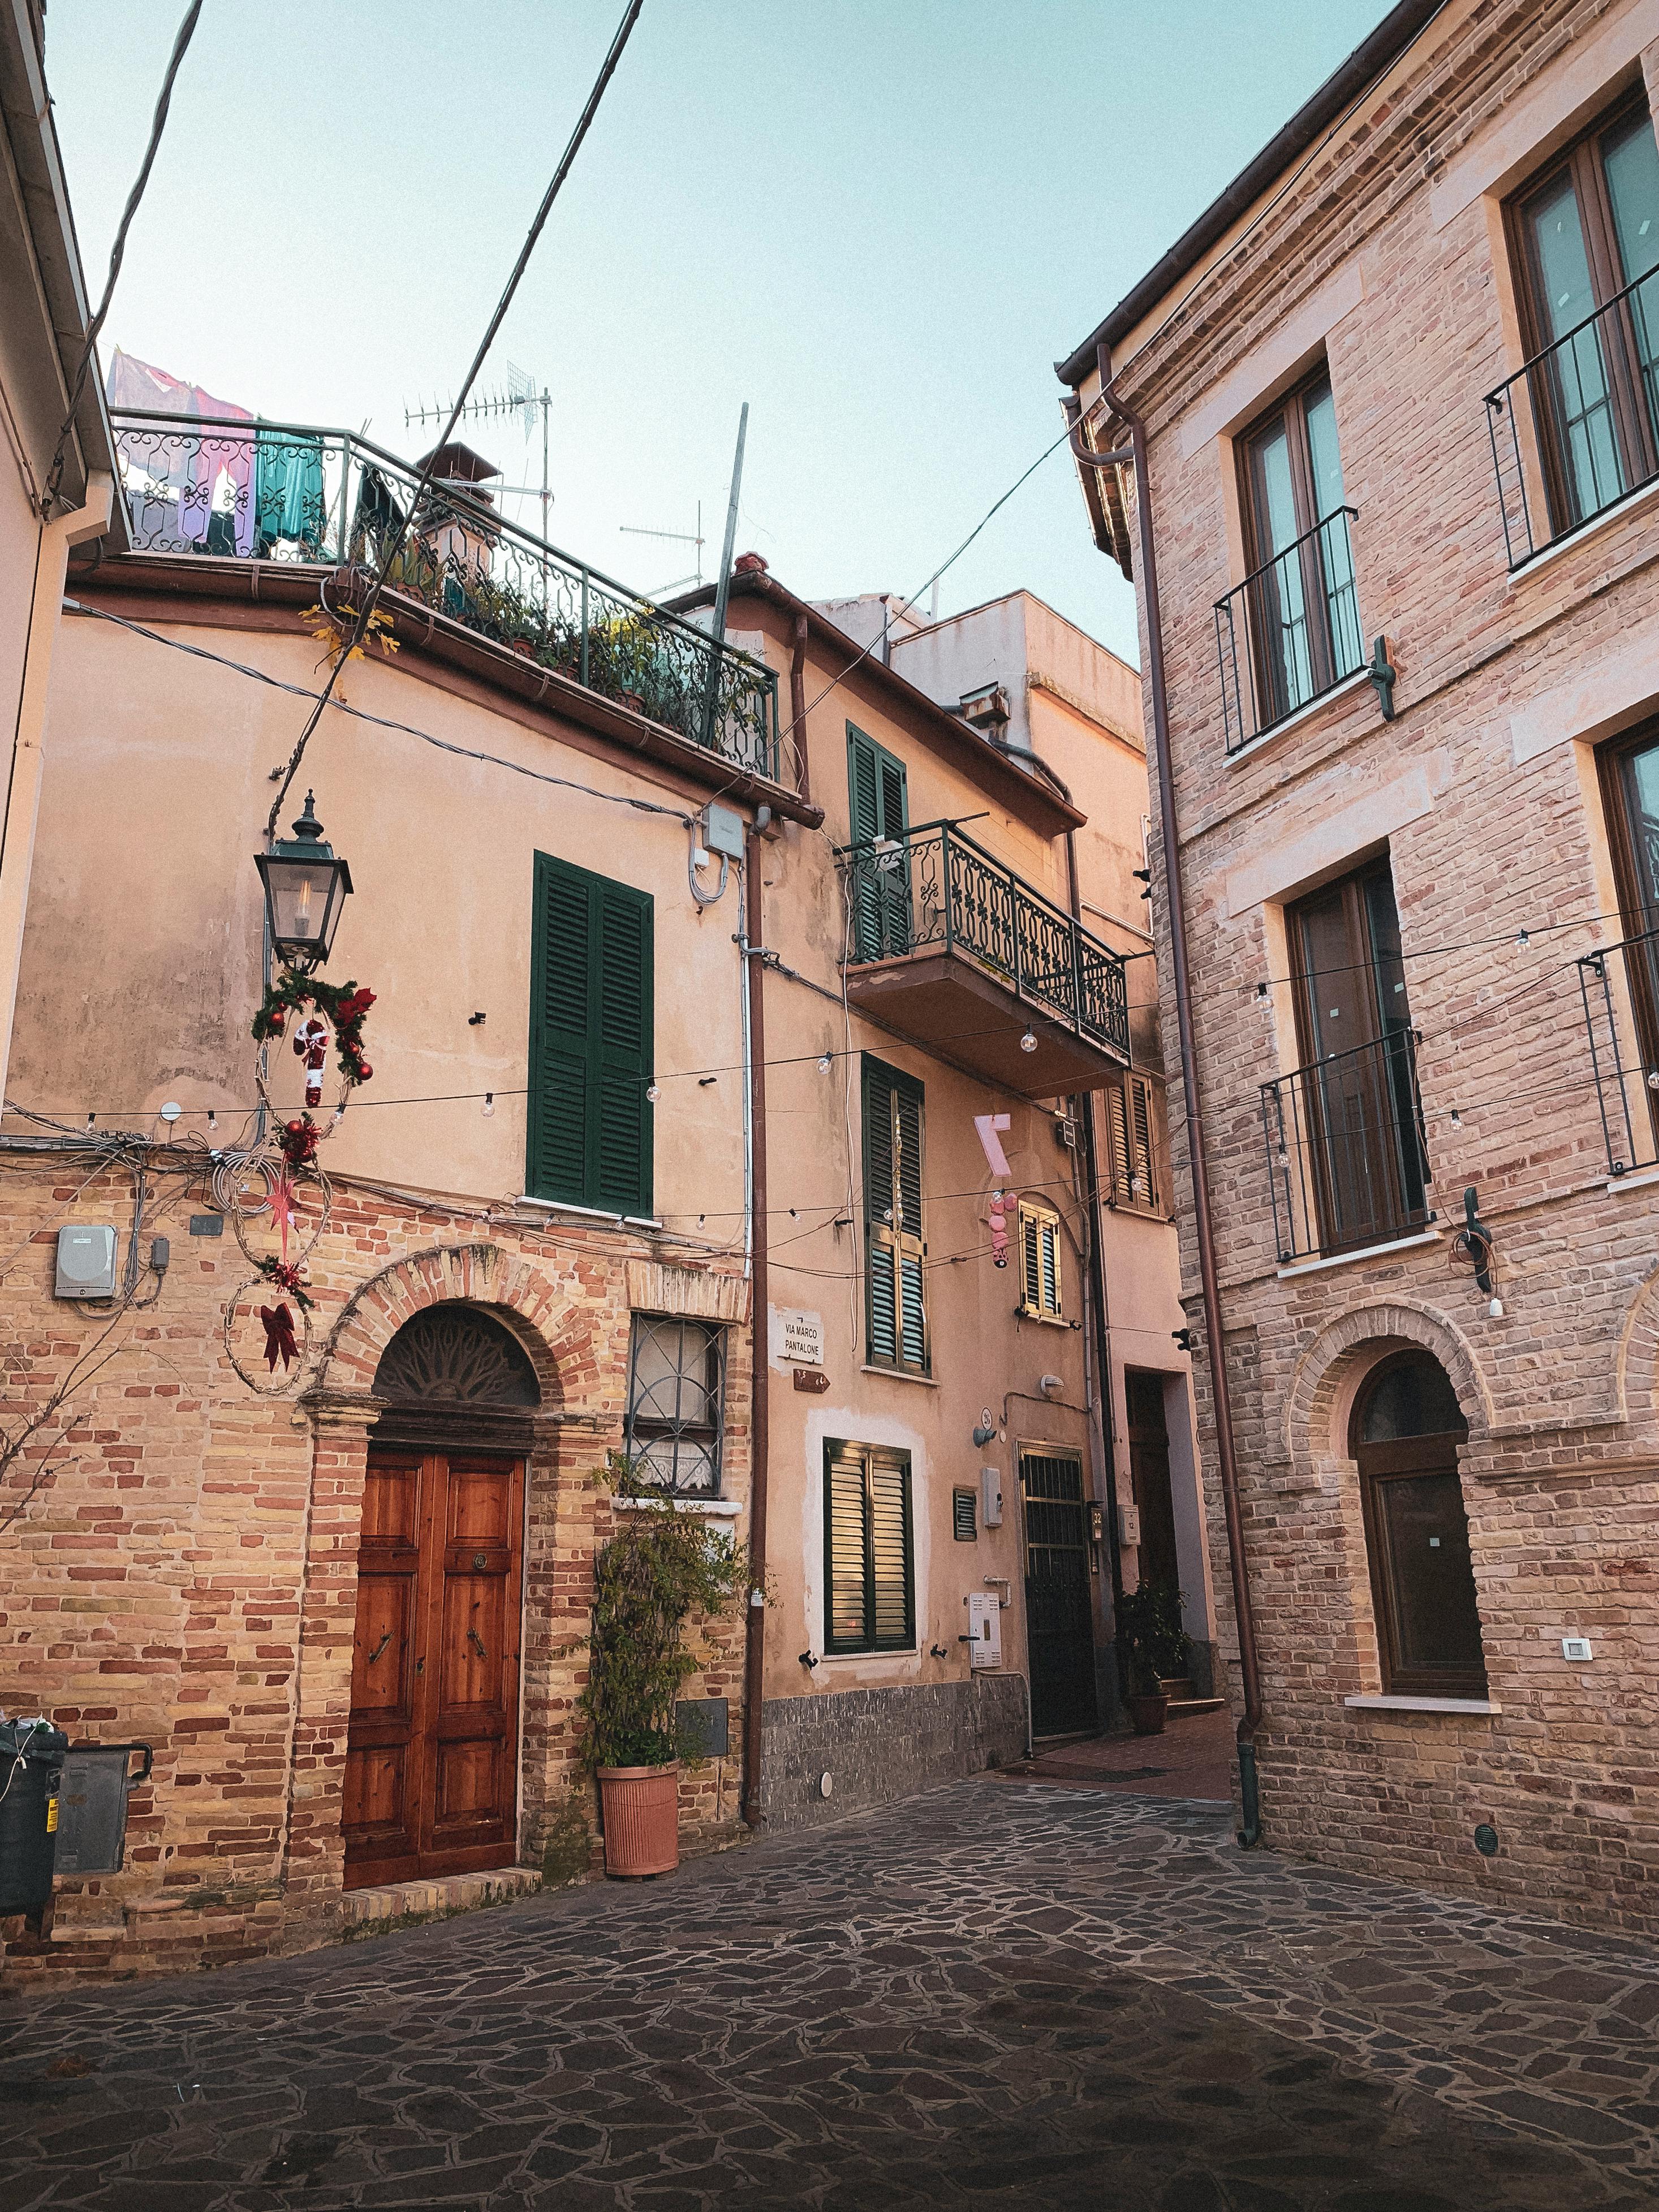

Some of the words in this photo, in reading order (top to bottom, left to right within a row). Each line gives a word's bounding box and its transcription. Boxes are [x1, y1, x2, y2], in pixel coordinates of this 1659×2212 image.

[786, 1323, 795, 1335] VIA
[796, 1326, 817, 1339] MARCO
[785, 1339, 819, 1356] PANTALONE
[1094, 1512, 1101, 1524] 32
